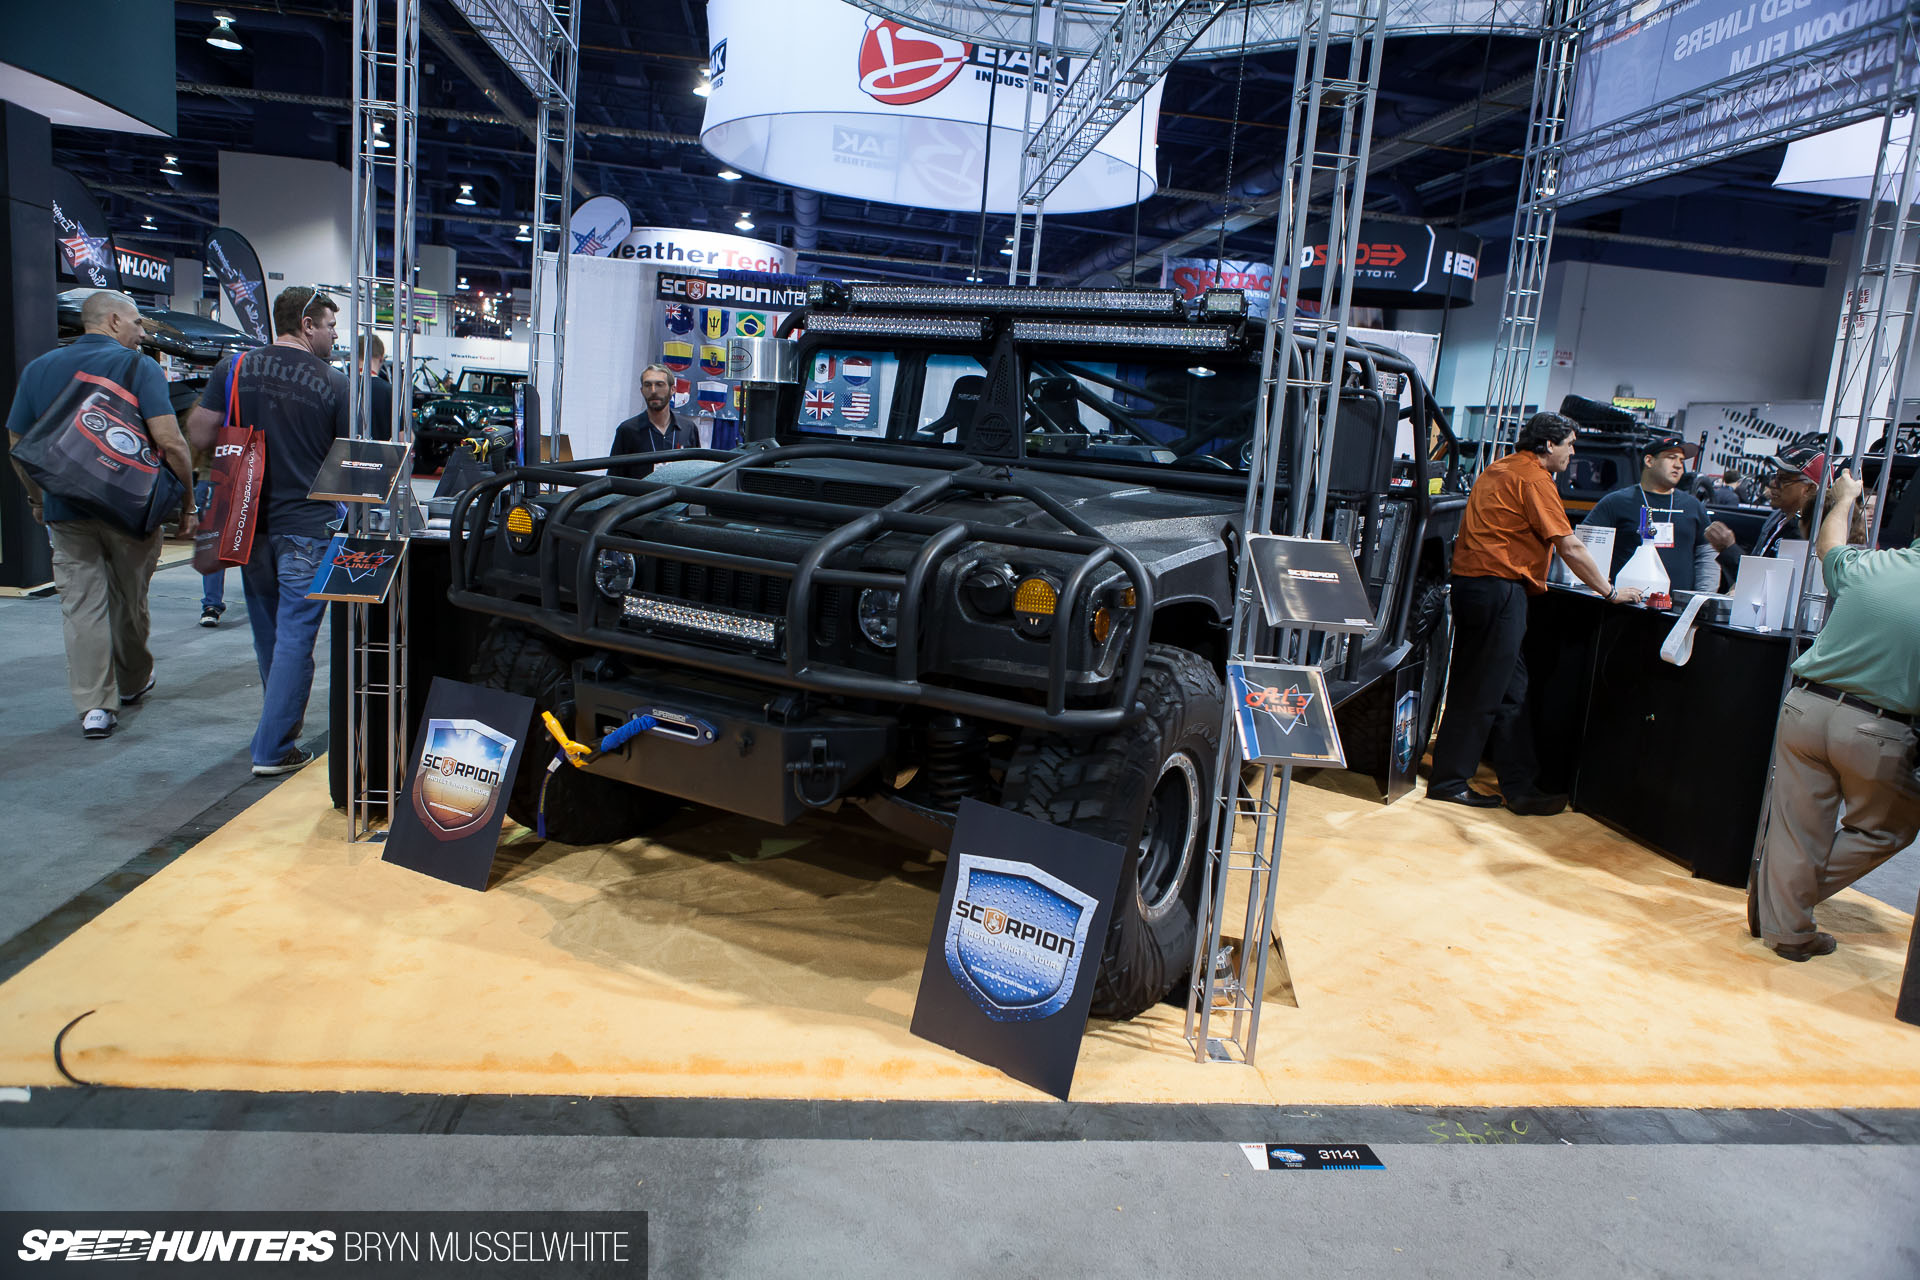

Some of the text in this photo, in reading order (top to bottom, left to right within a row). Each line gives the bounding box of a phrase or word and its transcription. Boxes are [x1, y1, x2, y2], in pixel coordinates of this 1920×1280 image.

[977, 45, 1066, 81] BAK
[1366, 269, 1382, 278] TO
[1264, 703, 1305, 715] LINER
[422, 753, 500, 786] SCORPION
[955, 899, 1076, 958] SCORPION
[1318, 1149, 1360, 1160] 31141
